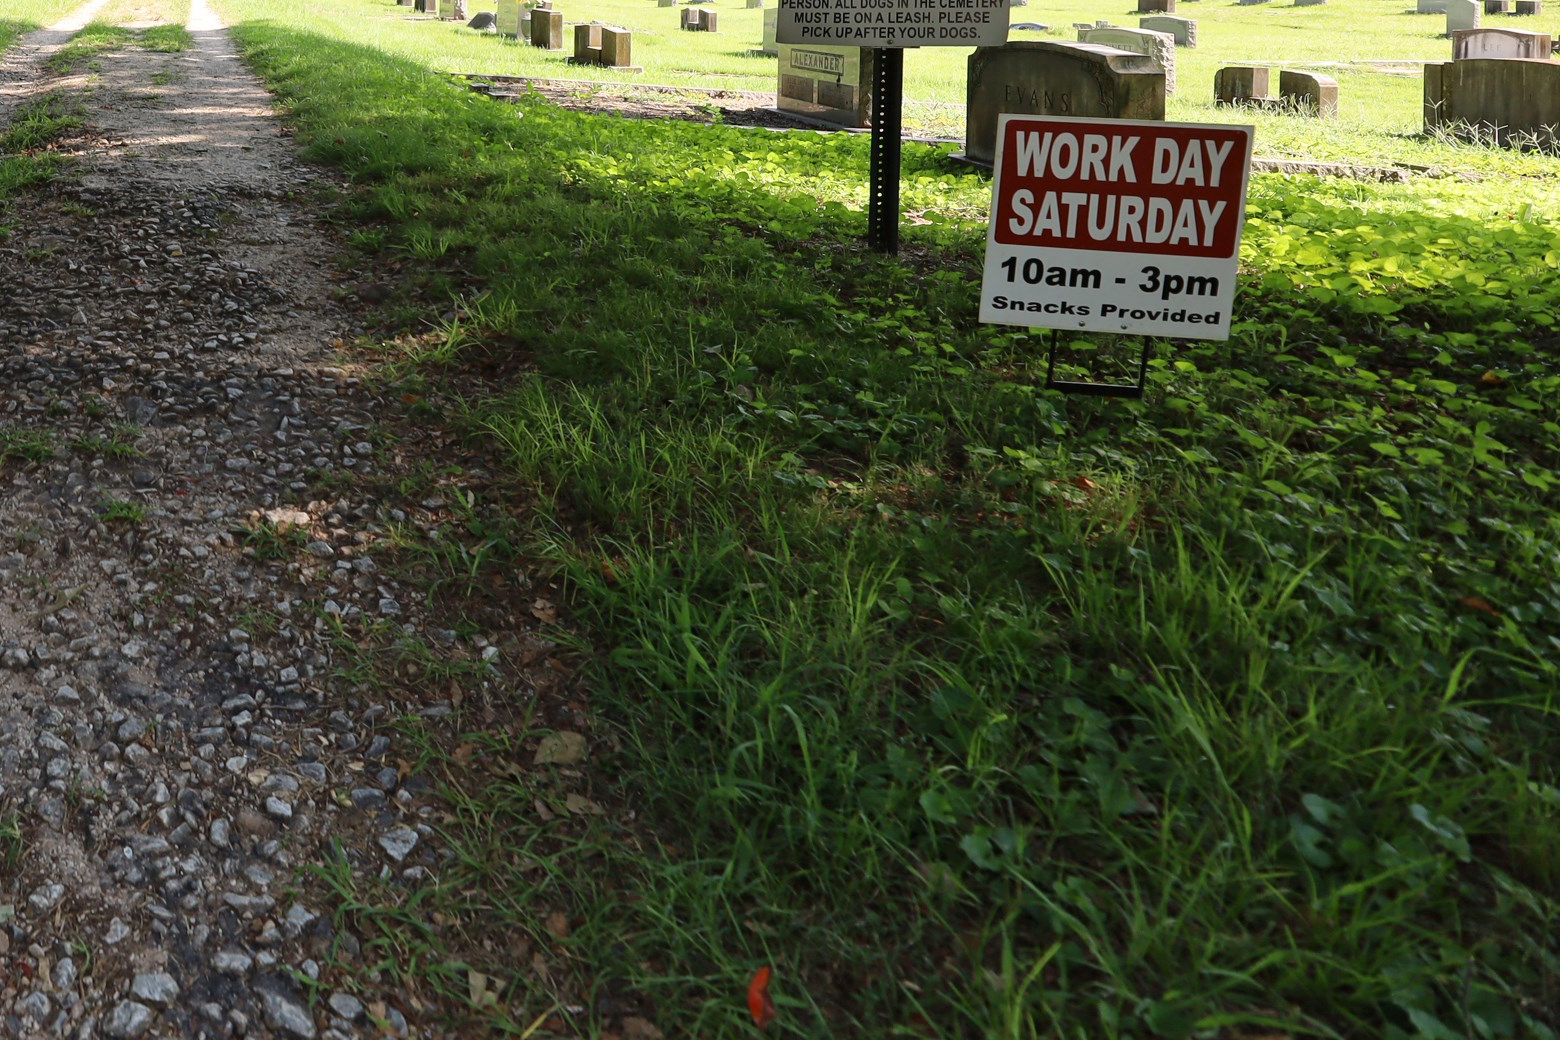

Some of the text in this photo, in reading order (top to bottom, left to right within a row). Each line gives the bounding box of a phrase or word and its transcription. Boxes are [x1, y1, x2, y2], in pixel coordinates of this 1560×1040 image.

[794, 12, 990, 23] MUST BE ON A LEASH. PLEASE
[802, 27, 980, 38] PICK UP AFTER YOUR DOGS.
[794, 52, 840, 71] ALEXANDER
[1005, 85, 1070, 112] EVANS
[1016, 131, 1235, 188] WORK DAY
[1008, 188, 1228, 247] SATURDAY
[1001, 256, 1102, 289] 10am
[1139, 265, 1219, 301] 3pm
[991, 295, 1221, 325] Snacks Provided
